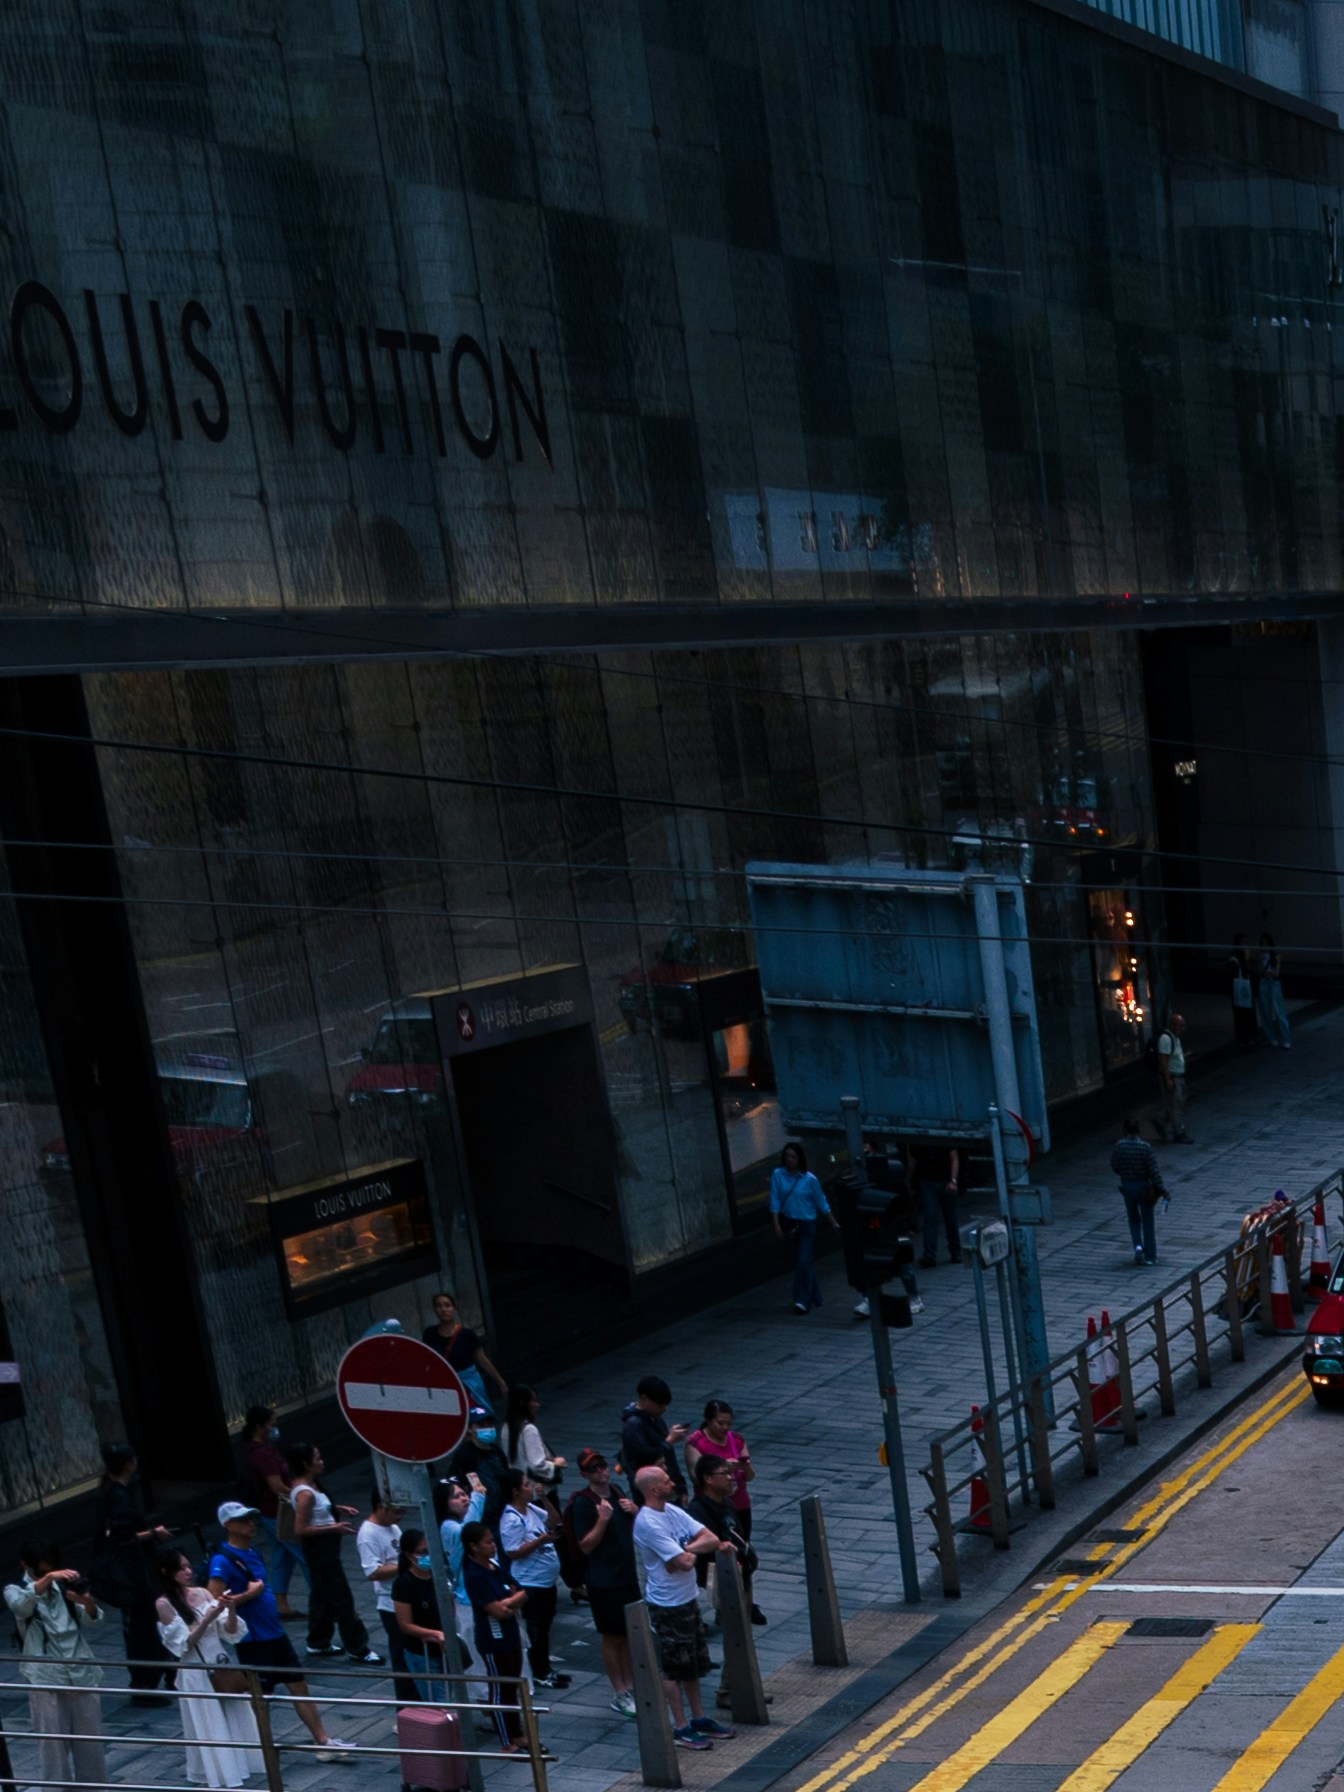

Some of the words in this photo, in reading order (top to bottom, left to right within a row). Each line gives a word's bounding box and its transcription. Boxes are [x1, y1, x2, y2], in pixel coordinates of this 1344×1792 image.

[0, 281, 228, 443] OUIS
[245, 305, 554, 472] VUITTON
[523, 1000, 549, 1022] Central
[550, 999, 575, 1016] Station
[314, 1193, 346, 1219] LOUIS
[347, 1180, 392, 1208] VUITTON
